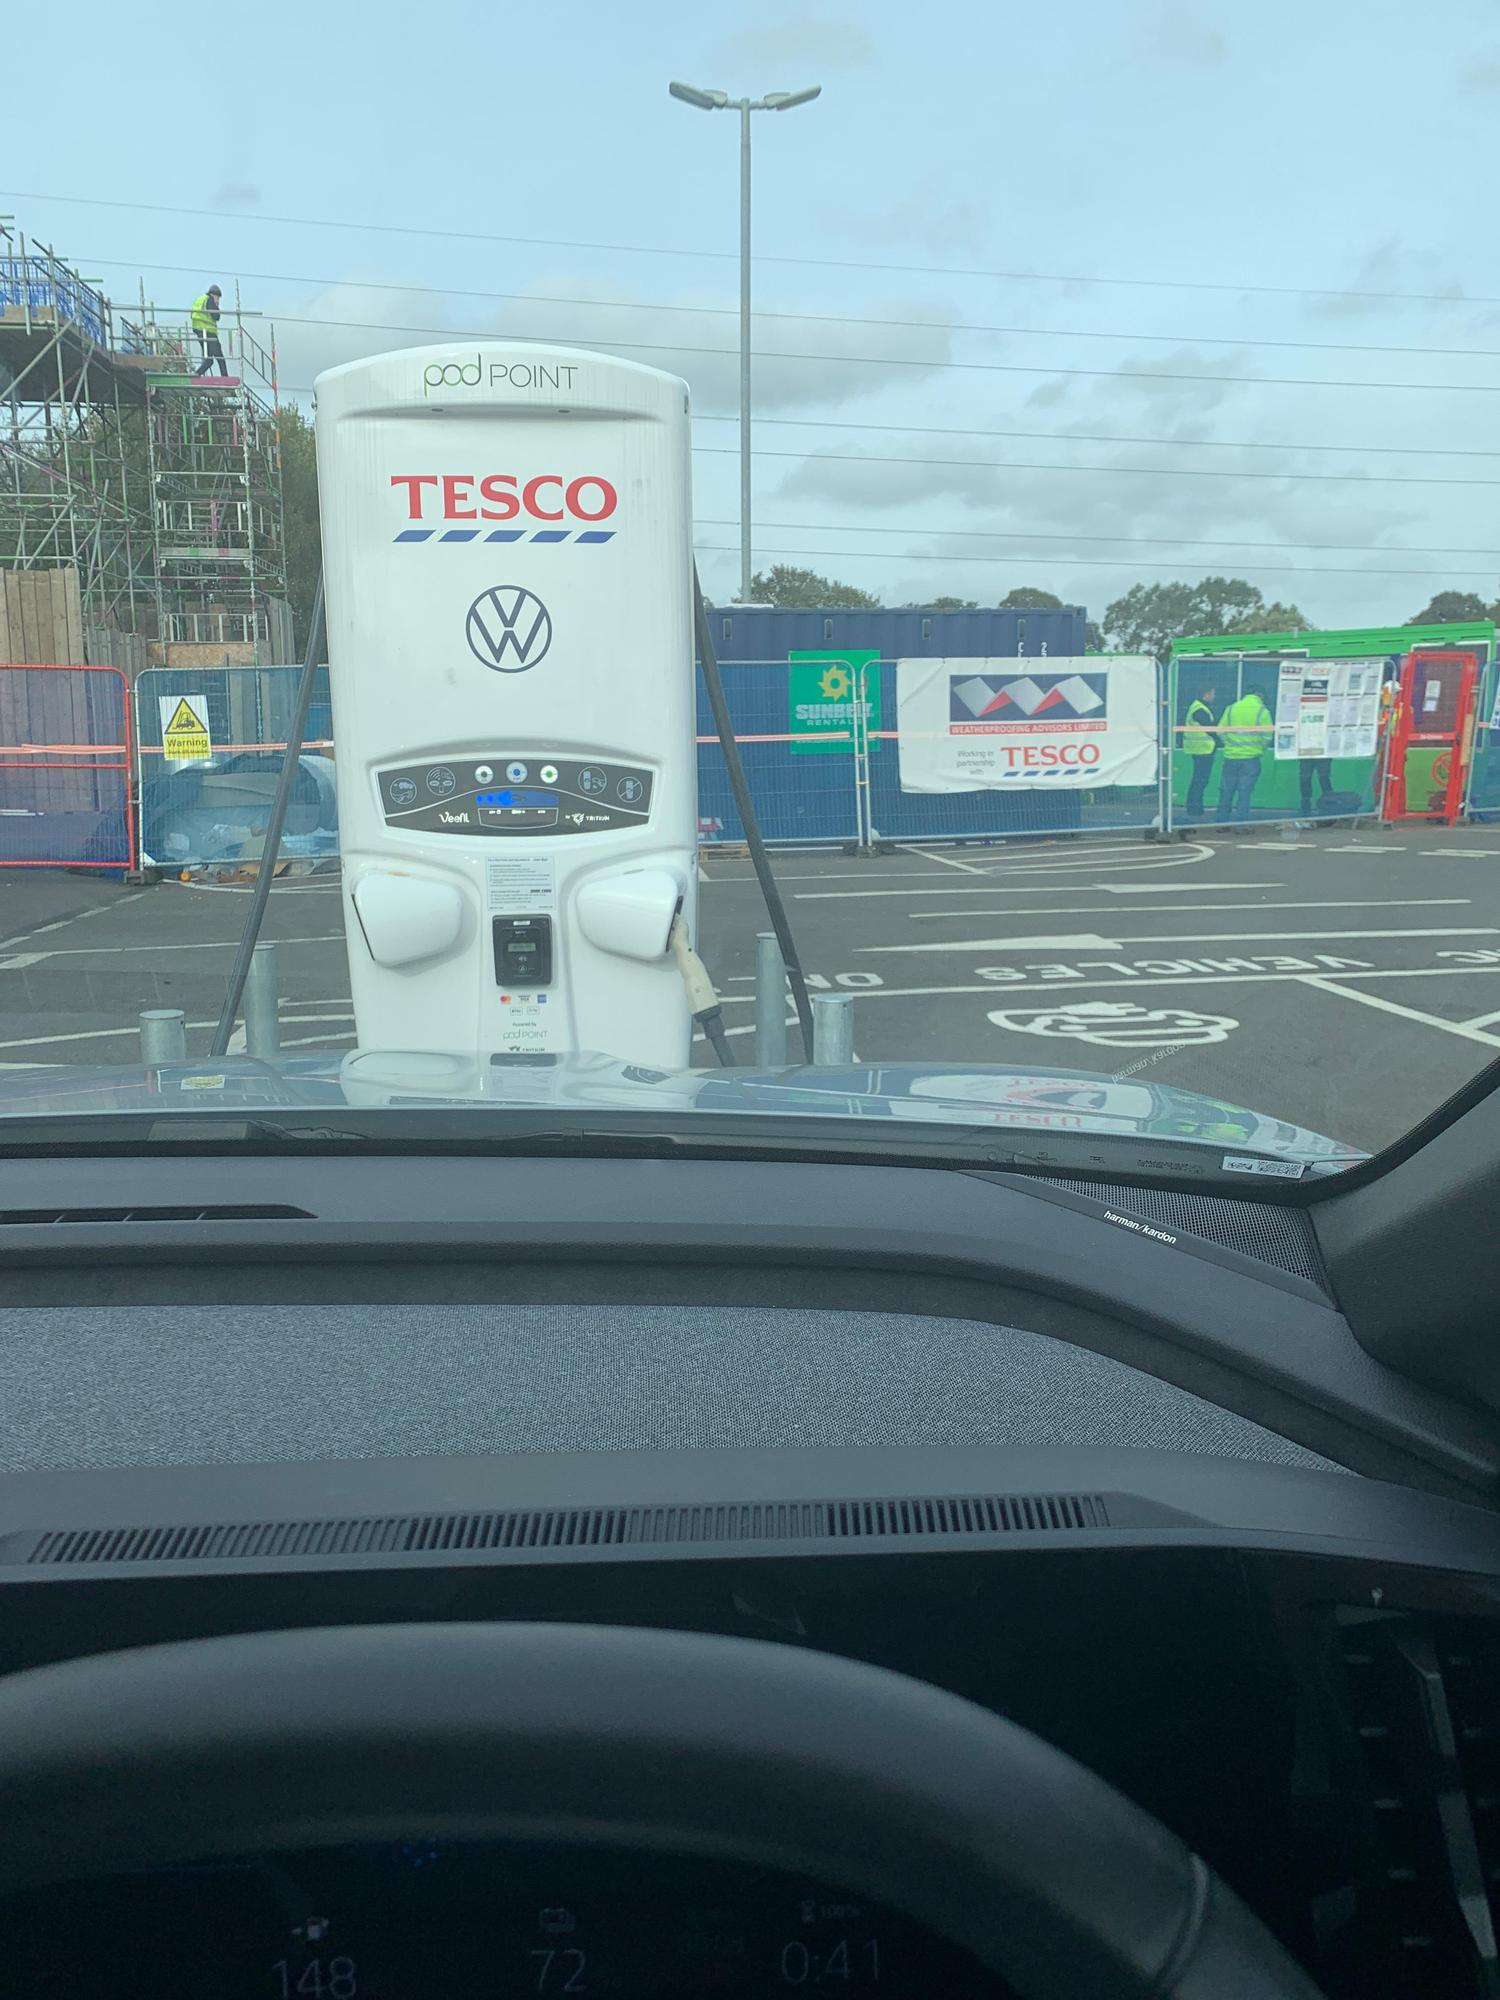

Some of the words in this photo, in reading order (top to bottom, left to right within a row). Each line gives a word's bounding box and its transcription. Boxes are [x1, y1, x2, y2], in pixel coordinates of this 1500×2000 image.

[490, 363, 579, 390] POINT
[390, 474, 618, 521] TESCO
[951, 725, 1031, 735] WEATHERPROOFING
[1031, 723, 1073, 733] ADVISORS
[1074, 722, 1106, 732] LIMITED
[166, 738, 208, 748] Warning
[957, 750, 987, 759] Working
[1000, 743, 1100, 767] TESCO
[956, 759, 996, 769] partnership
[974, 954, 1375, 982] VEHICLES
[1103, 1210, 1177, 1244] harman/kardon
[530, 1948, 588, 1994] 72
[780, 1938, 880, 1985] 0:41
[271, 1955, 358, 2000] 148
